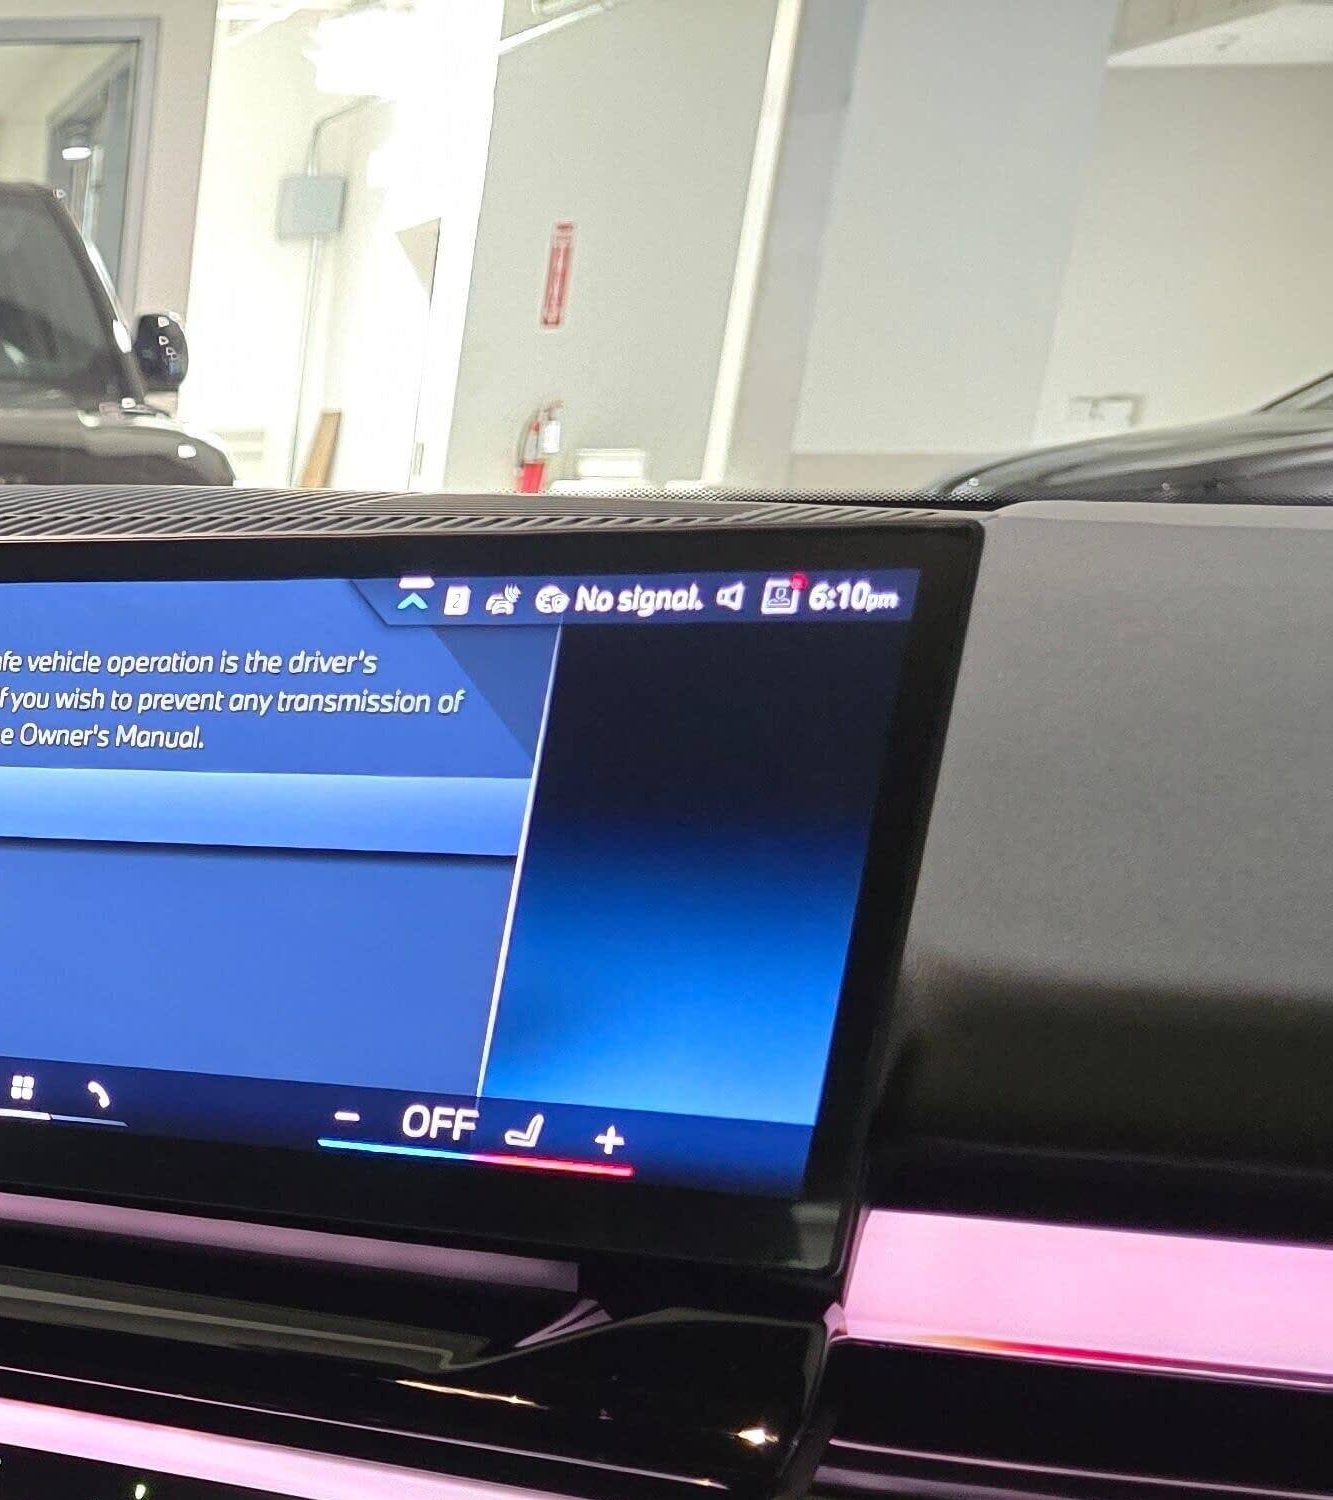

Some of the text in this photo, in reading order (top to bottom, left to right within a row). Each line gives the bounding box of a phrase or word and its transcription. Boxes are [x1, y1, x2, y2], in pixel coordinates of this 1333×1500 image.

[574, 582, 704, 617] No signal.
[27, 650, 102, 673] vehicle
[106, 650, 214, 677] operation
[219, 649, 239, 674] is
[244, 649, 283, 674] the
[288, 649, 378, 674] driver's
[10, 690, 49, 713] you
[55, 687, 105, 711] wish
[110, 690, 133, 711] to
[137, 690, 225, 714] prevent
[228, 692, 273, 716] any
[277, 688, 431, 714] transmission
[436, 689, 467, 714] of
[19, 722, 110, 747] Owner's
[115, 724, 205, 750] Manual.
[401, 1103, 481, 1141] OFF
